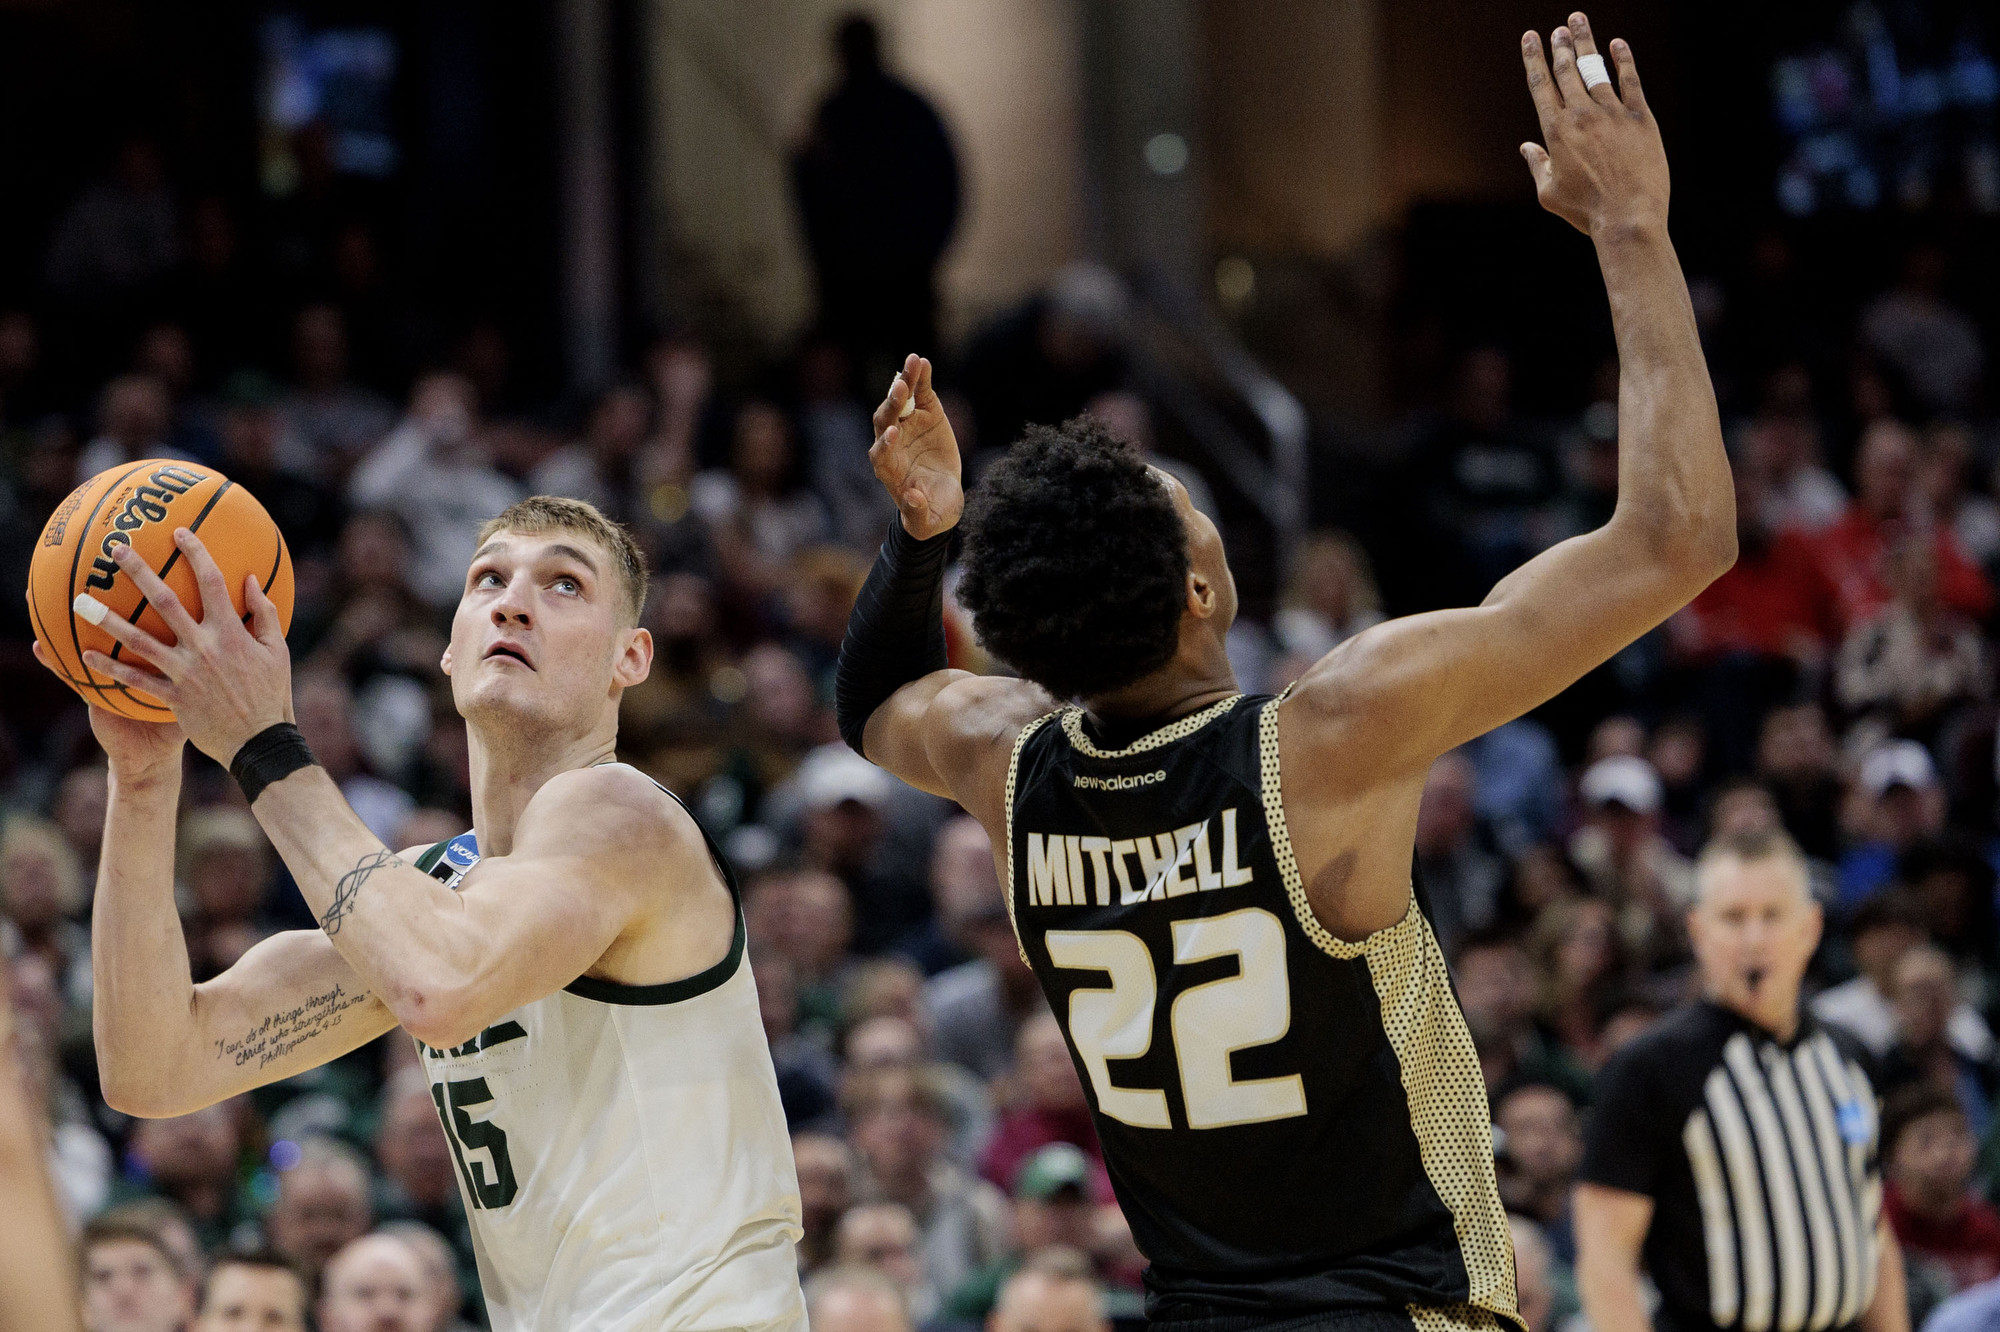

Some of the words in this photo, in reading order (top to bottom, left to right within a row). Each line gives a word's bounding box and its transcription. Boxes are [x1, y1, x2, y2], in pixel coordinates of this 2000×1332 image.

[86, 465, 209, 591] Wilson
[1026, 807, 1254, 906] MITCHELL
[225, 1040, 244, 1054] can
[245, 1028, 257, 1044] do
[258, 1016, 271, 1036] all
[273, 1006, 304, 1028] things
[304, 983, 346, 1012] through
[235, 1037, 266, 1066] Christ
[269, 1028, 290, 1045] who
[1044, 906, 1308, 1130] 22
[431, 1076, 518, 1210] 15
